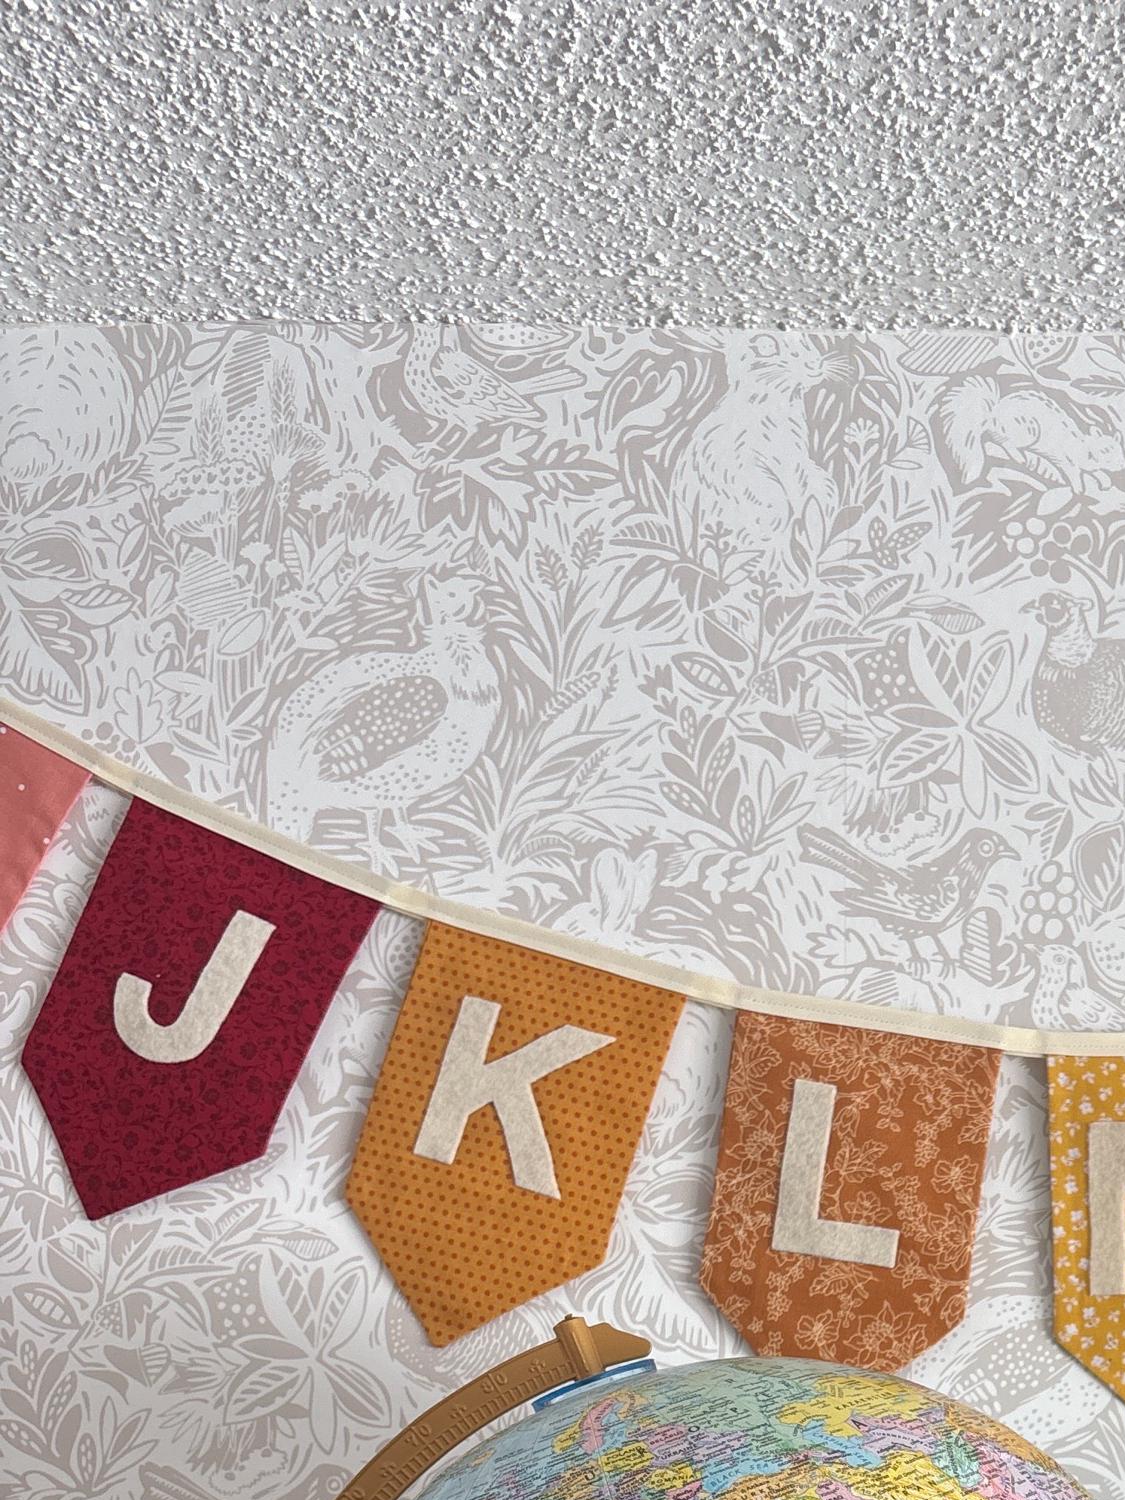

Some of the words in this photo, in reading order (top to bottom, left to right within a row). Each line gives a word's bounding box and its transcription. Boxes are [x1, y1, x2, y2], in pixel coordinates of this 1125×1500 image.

[113, 909, 277, 1063] J
[413, 995, 617, 1200] K
[771, 1078, 899, 1268] L
[711, 1469, 741, 1487] BLACK
[749, 1463, 769, 1472] SEA
